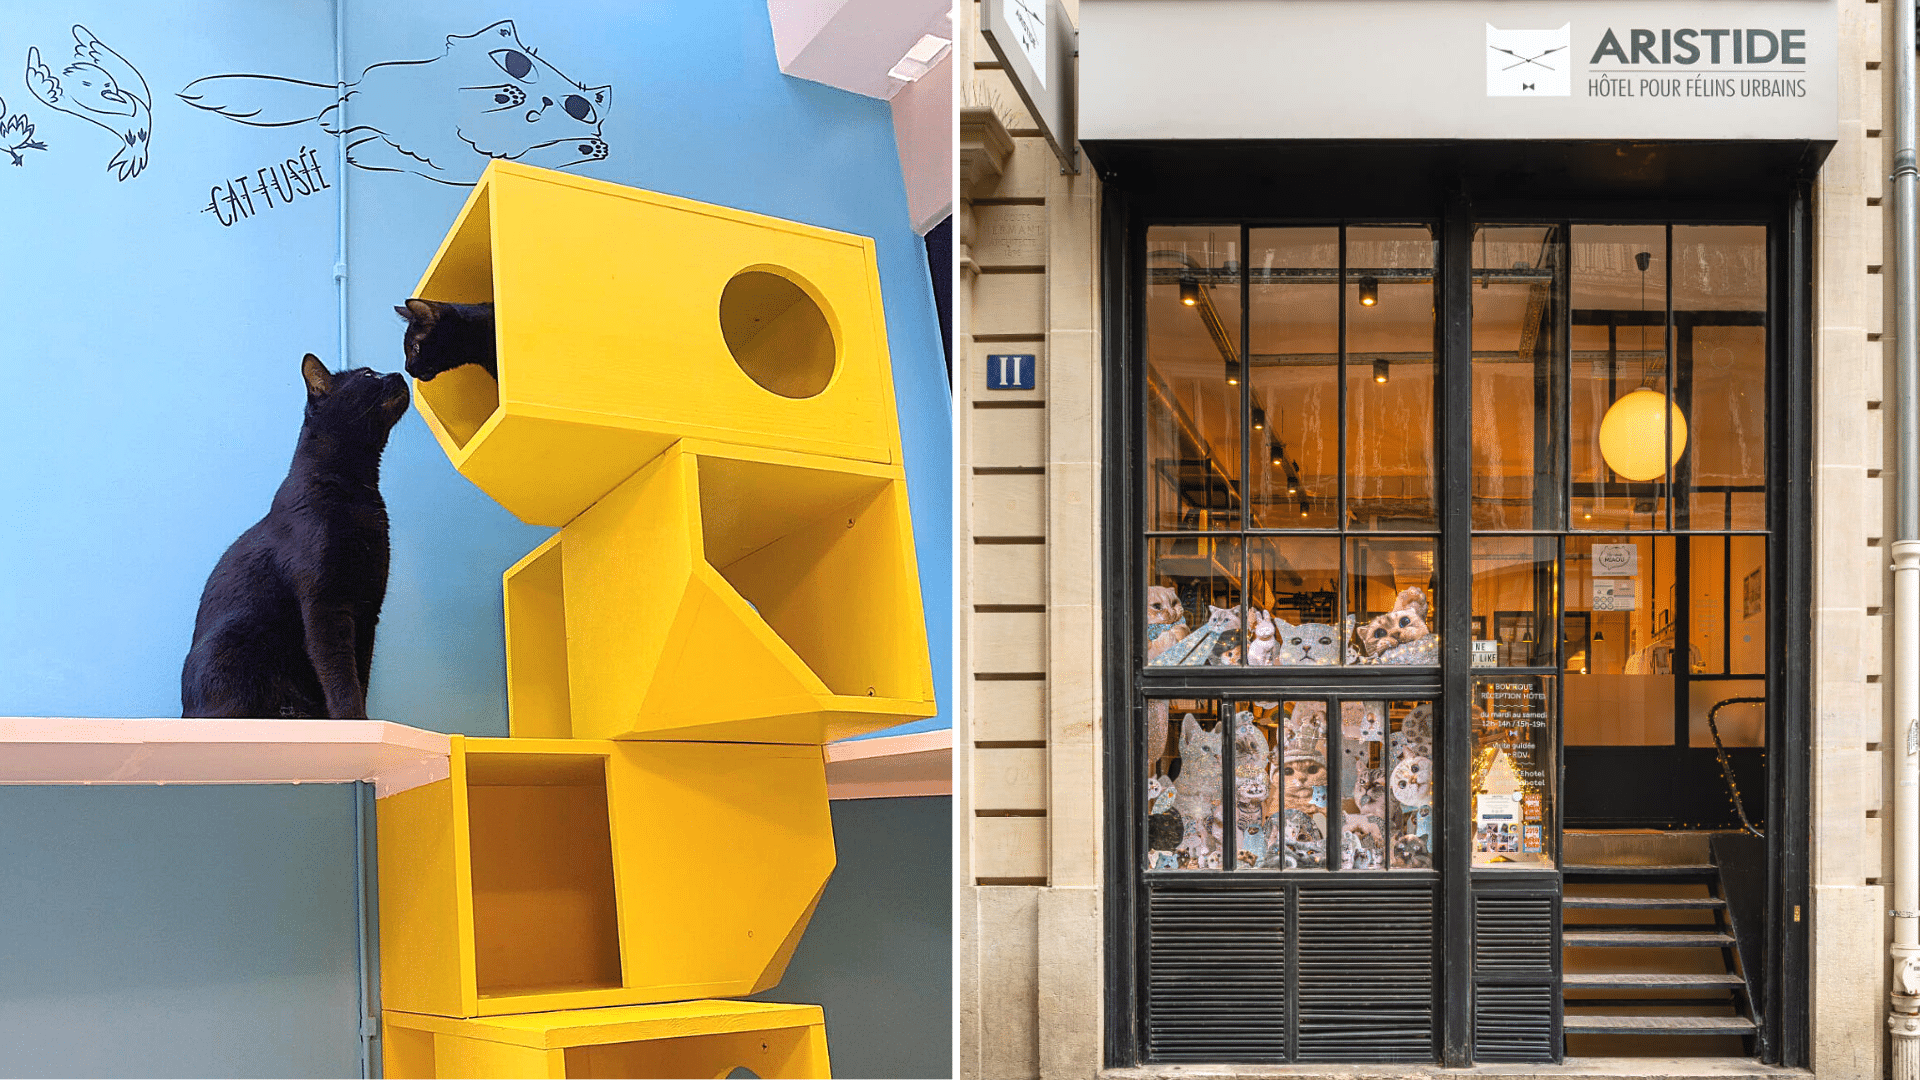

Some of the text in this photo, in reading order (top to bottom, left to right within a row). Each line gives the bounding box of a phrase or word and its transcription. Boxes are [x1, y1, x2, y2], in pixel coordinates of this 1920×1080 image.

[1589, 27, 1806, 65] ARISTIDE
[1588, 73, 1806, 97] HÔTEL POUR FÉLINS URBAINS
[200, 145, 331, 227] CAT FUSÉE
[1479, 653, 1496, 662] LIKE
